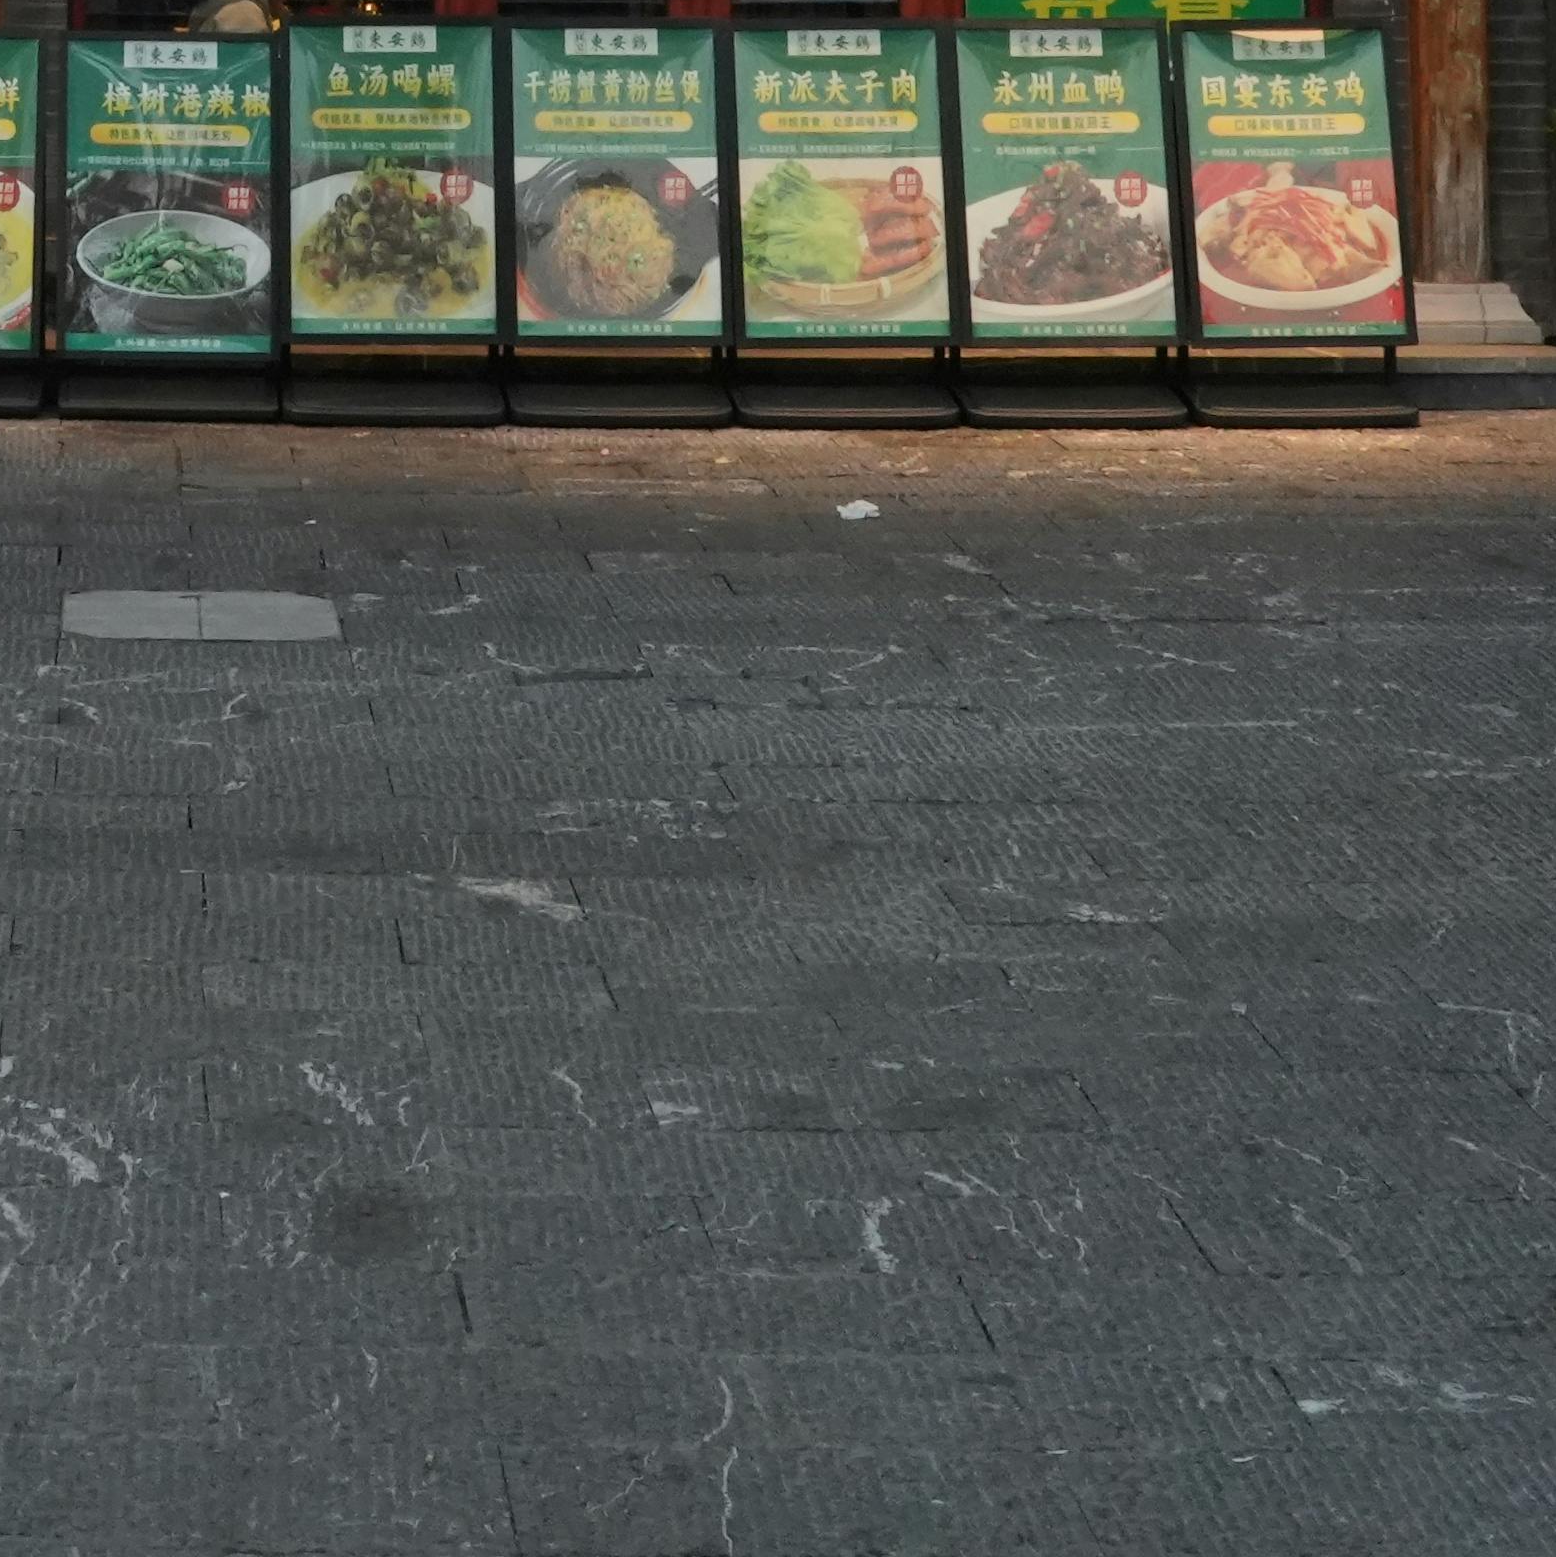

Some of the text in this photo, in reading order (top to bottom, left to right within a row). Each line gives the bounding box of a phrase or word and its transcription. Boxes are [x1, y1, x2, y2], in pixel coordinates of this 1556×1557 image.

[993, 71, 1126, 106] 永州血鸭
[1201, 71, 1366, 109] 国宴东安鸡
